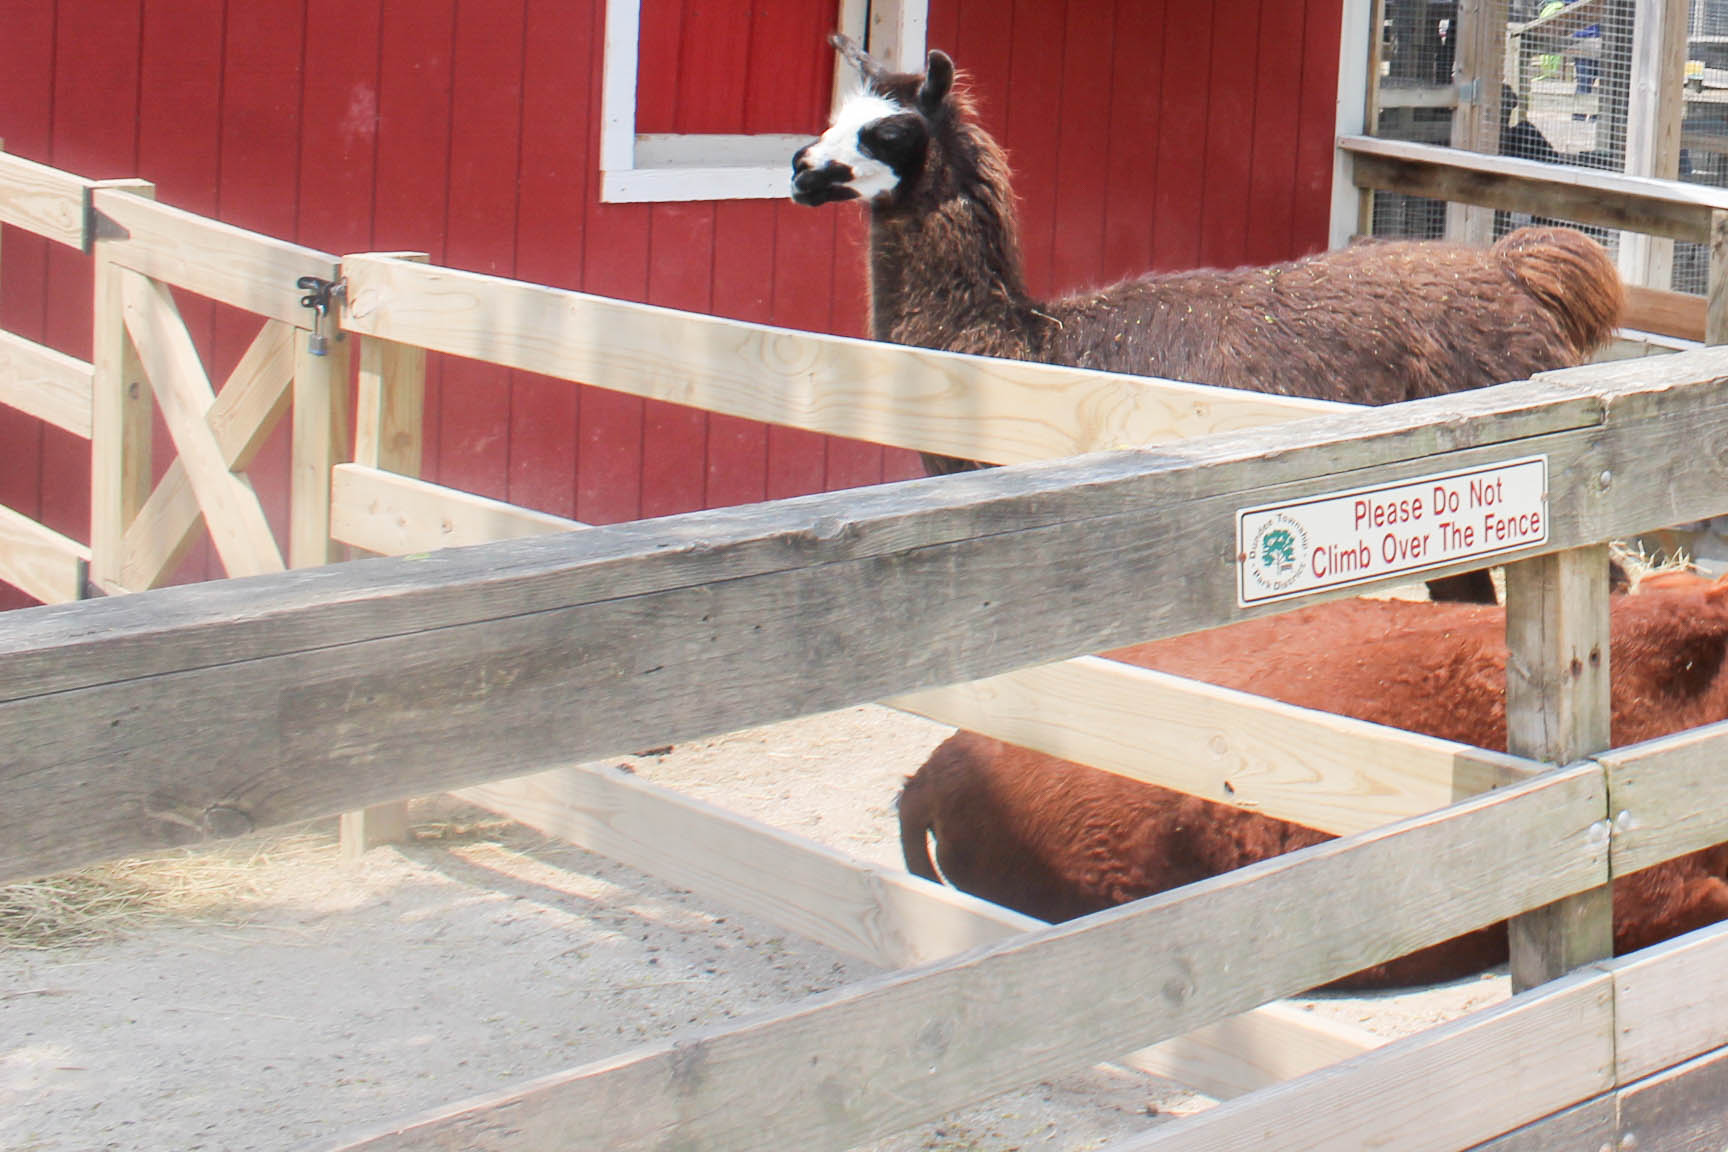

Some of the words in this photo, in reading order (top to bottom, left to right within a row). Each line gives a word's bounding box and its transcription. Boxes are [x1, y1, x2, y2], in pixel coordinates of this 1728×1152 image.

[1354, 496, 1423, 531] Please
[1433, 486, 1460, 516] Do
[1469, 476, 1503, 509] Not
[1311, 535, 1371, 579] Climb
[1382, 532, 1430, 564] Over
[1439, 521, 1474, 552] The
[1484, 511, 1541, 543] Fence
